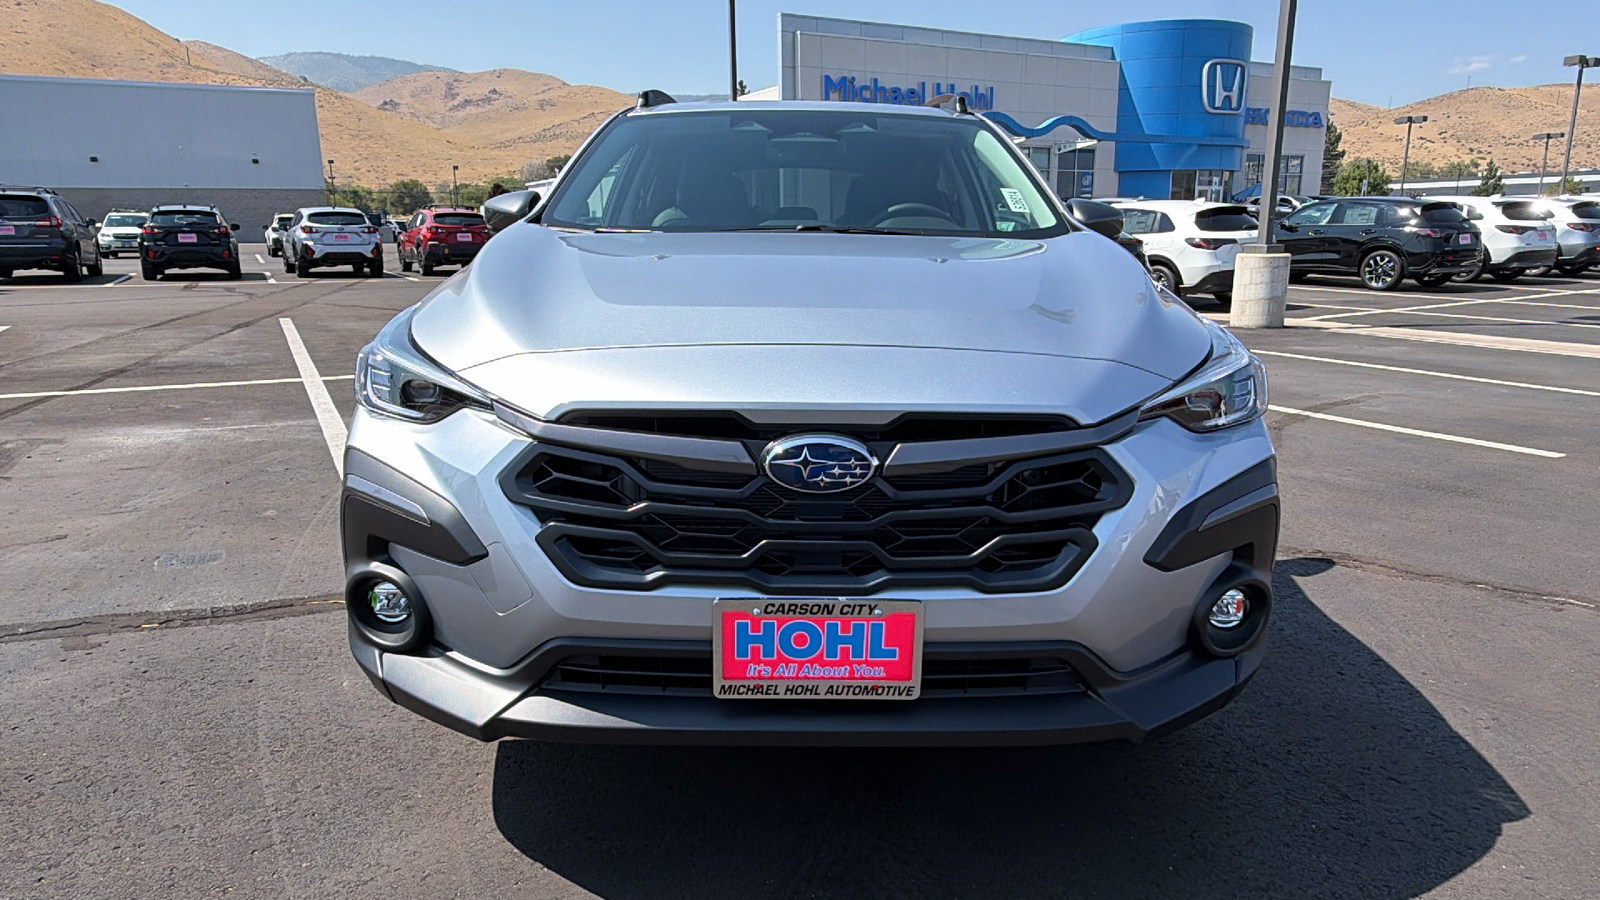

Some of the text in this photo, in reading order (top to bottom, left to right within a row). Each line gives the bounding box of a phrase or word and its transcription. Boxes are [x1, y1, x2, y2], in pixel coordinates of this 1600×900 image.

[823, 74, 926, 105] Michael
[1245, 107, 1325, 128] HDA
[763, 603, 878, 615] CARSON CITY
[735, 620, 898, 660] HOHL
[747, 663, 886, 677] It's All About You.
[718, 684, 915, 696] MICHAEL HOHL AUTOMOTIVE
